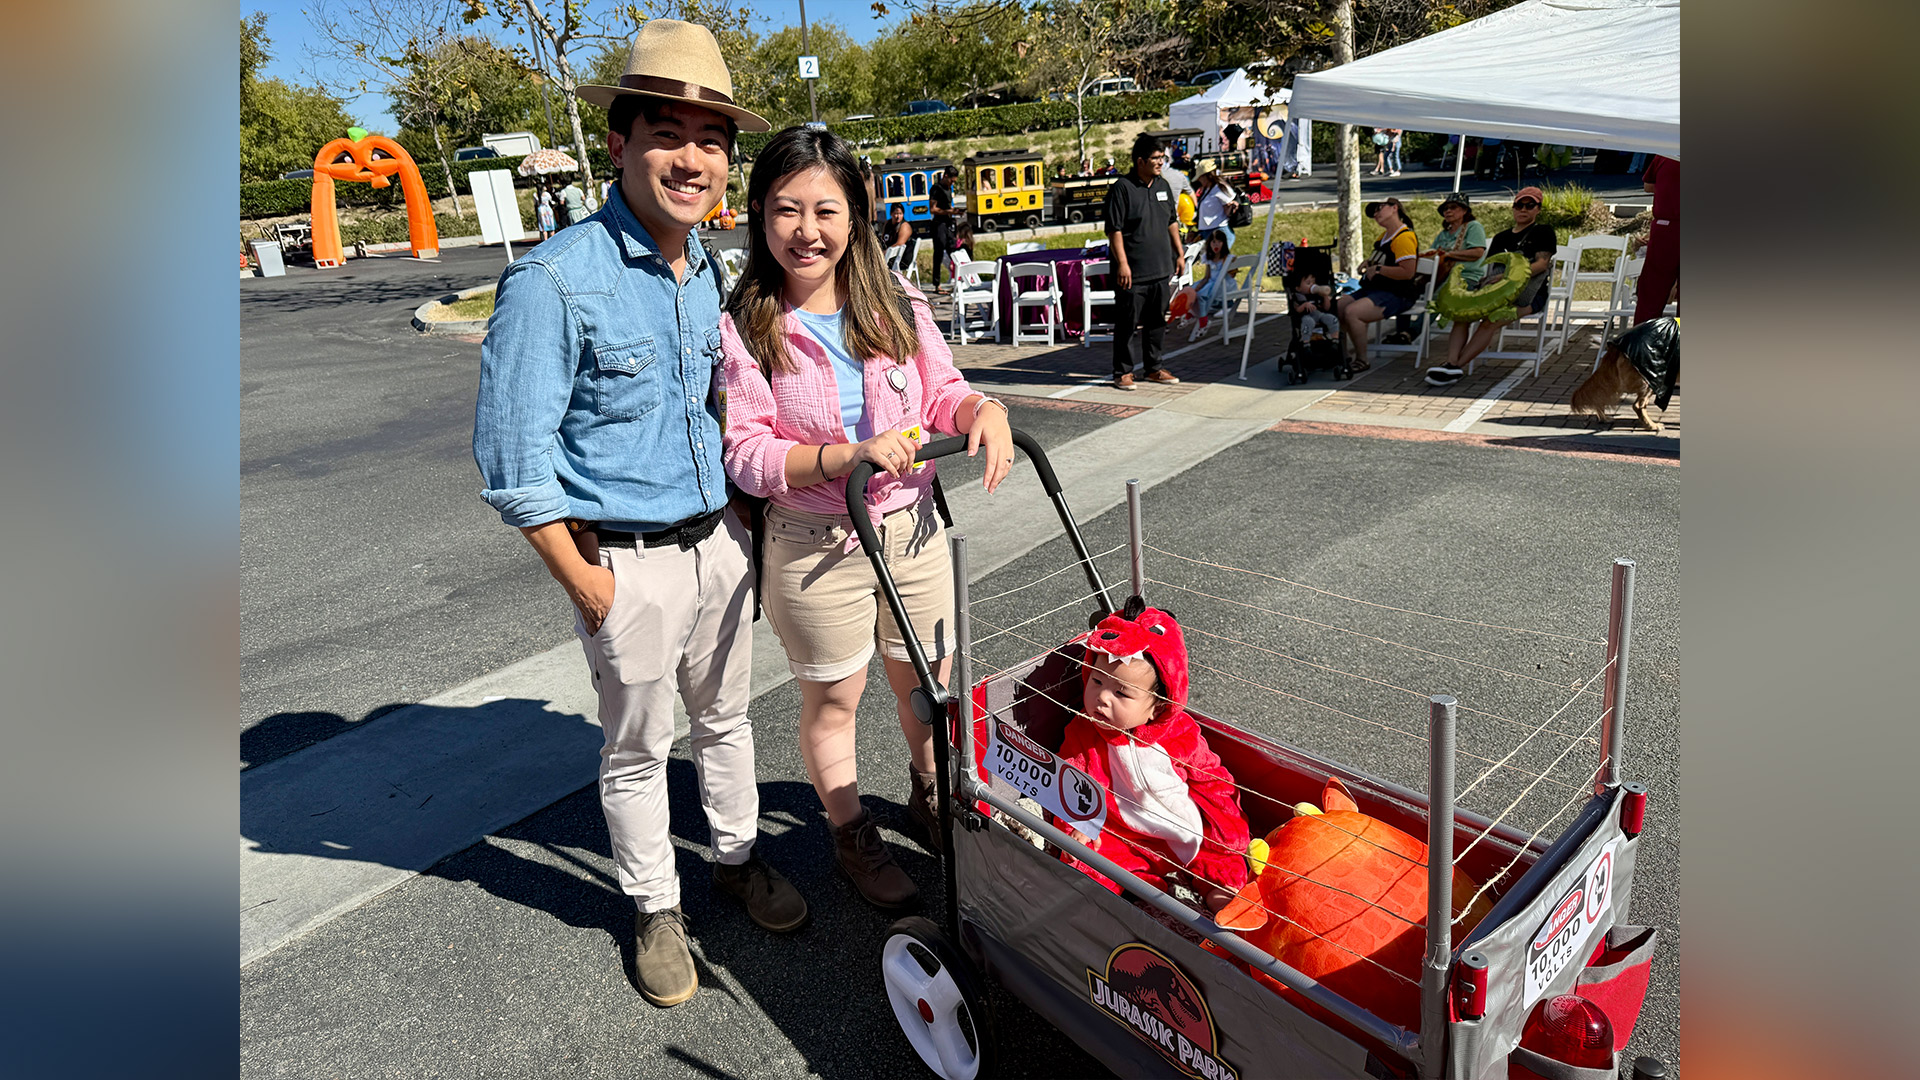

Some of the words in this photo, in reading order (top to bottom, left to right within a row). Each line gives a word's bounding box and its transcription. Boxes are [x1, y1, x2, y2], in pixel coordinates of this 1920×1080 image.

[805, 60, 813, 74] 2
[1004, 726, 1047, 761] DANGER
[996, 743, 1052, 789] 10,000
[997, 764, 1039, 797] VOLTS
[1545, 895, 1580, 939] ANGER
[1531, 917, 1581, 981] 10,000
[1538, 945, 1573, 990] VOLTS
[1092, 977, 1176, 1052] JURASSIC
